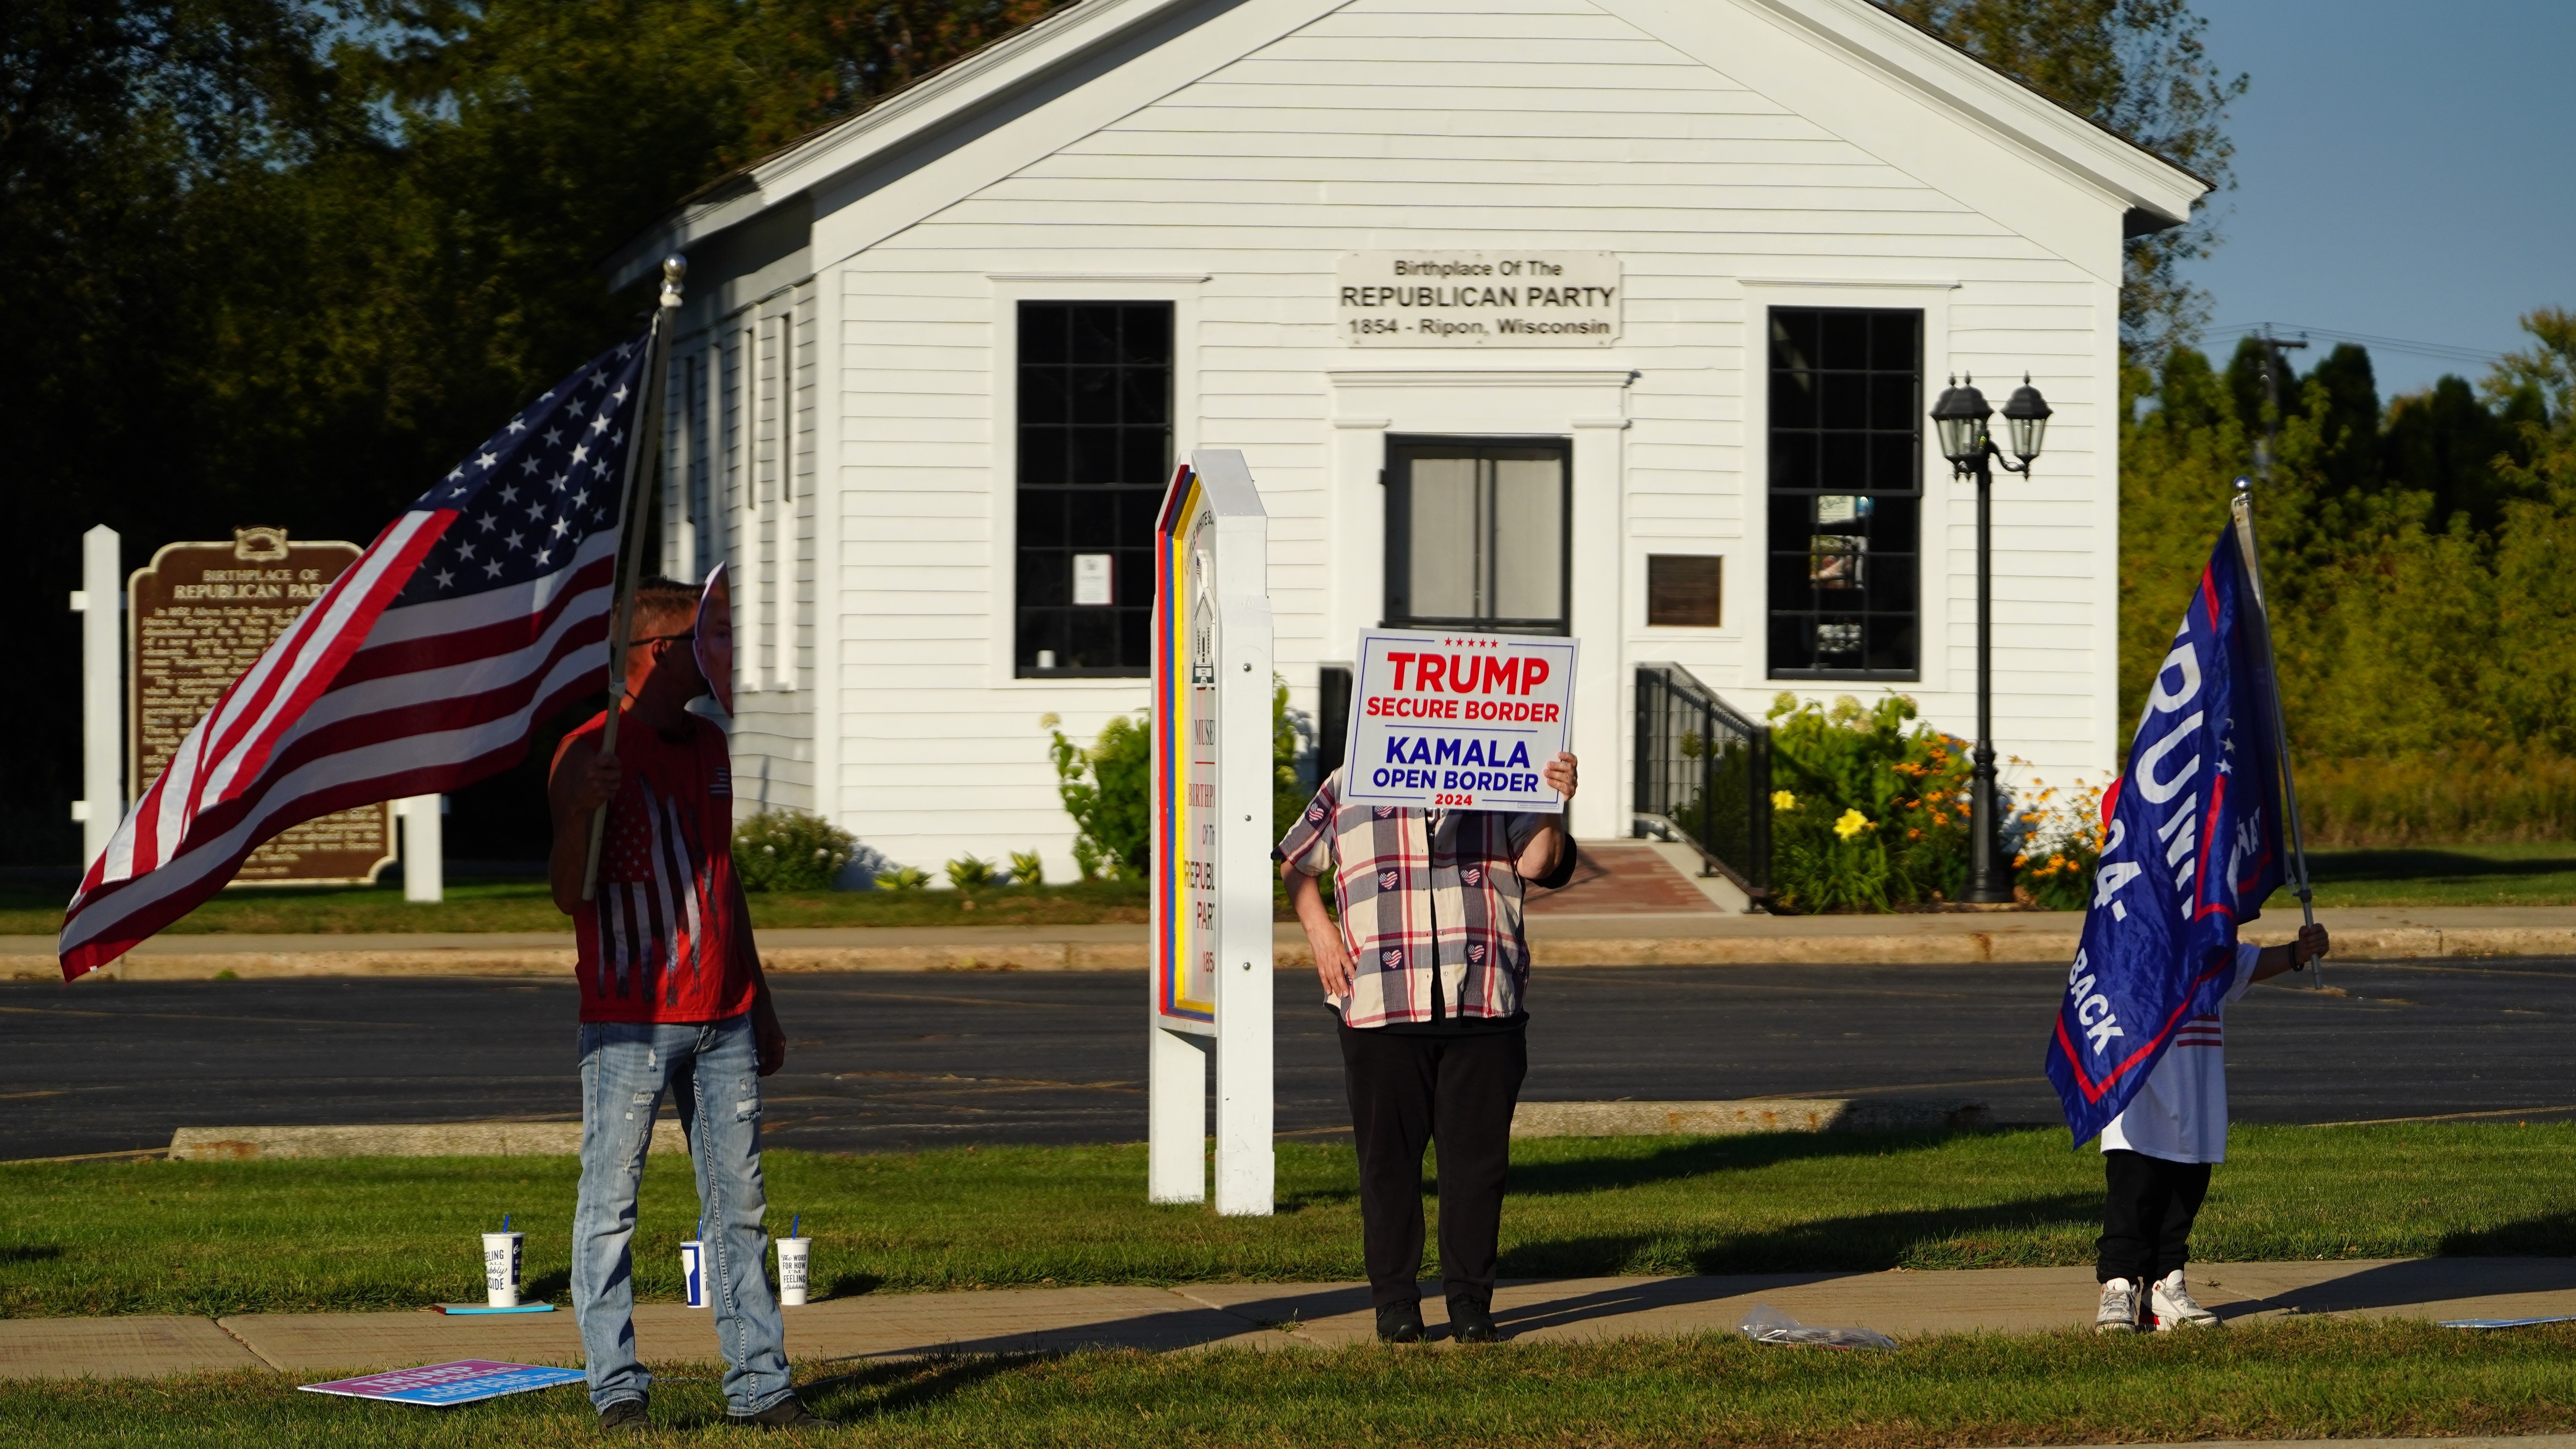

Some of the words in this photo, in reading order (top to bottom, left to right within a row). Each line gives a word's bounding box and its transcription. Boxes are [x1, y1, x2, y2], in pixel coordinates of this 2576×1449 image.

[1394, 260, 1493, 278] Birthplace
[1498, 260, 1522, 276] Of
[1527, 260, 1563, 276] The
[1341, 286, 1516, 307] REPUBLICAN
[1526, 286, 1616, 307] PARTY
[1349, 319, 1397, 334] 1854
[1419, 319, 1490, 337] Ripon,
[1497, 319, 1610, 334] Wisconsin
[1196, 511, 1207, 538] WHITE
[202, 569, 293, 582] BIRTHPLACE
[299, 569, 321, 580] OF
[173, 584, 282, 598] REPUBLICAN
[287, 583, 334, 598] PART
[1387, 651, 1549, 696] TRUMP
[1366, 696, 1459, 718] SECURE
[1465, 700, 1559, 723] BORDER
[1195, 720, 1215, 745] MUSE
[1386, 736, 1531, 768] KAMALA
[1373, 768, 1437, 789] OPEN
[1443, 771, 1539, 792] BORDER
[1188, 783, 1215, 808] BIRTHP
[1435, 793, 1473, 805] 2024
[1203, 823, 1208, 845] Of
[1185, 860, 1215, 890] REPUBL
[1197, 901, 1215, 930] PAR
[1203, 951, 1215, 973] 185
[2069, 948, 2125, 1056] BACK
[350, 1366, 473, 1387] TRUMP
[368, 1380, 431, 1394] LOW
[432, 1367, 522, 1383] PRICES
[421, 1385, 484, 1398] HIGH
[485, 1372, 571, 1388] PRICES
[425, 1373, 525, 1392] KAMALA
